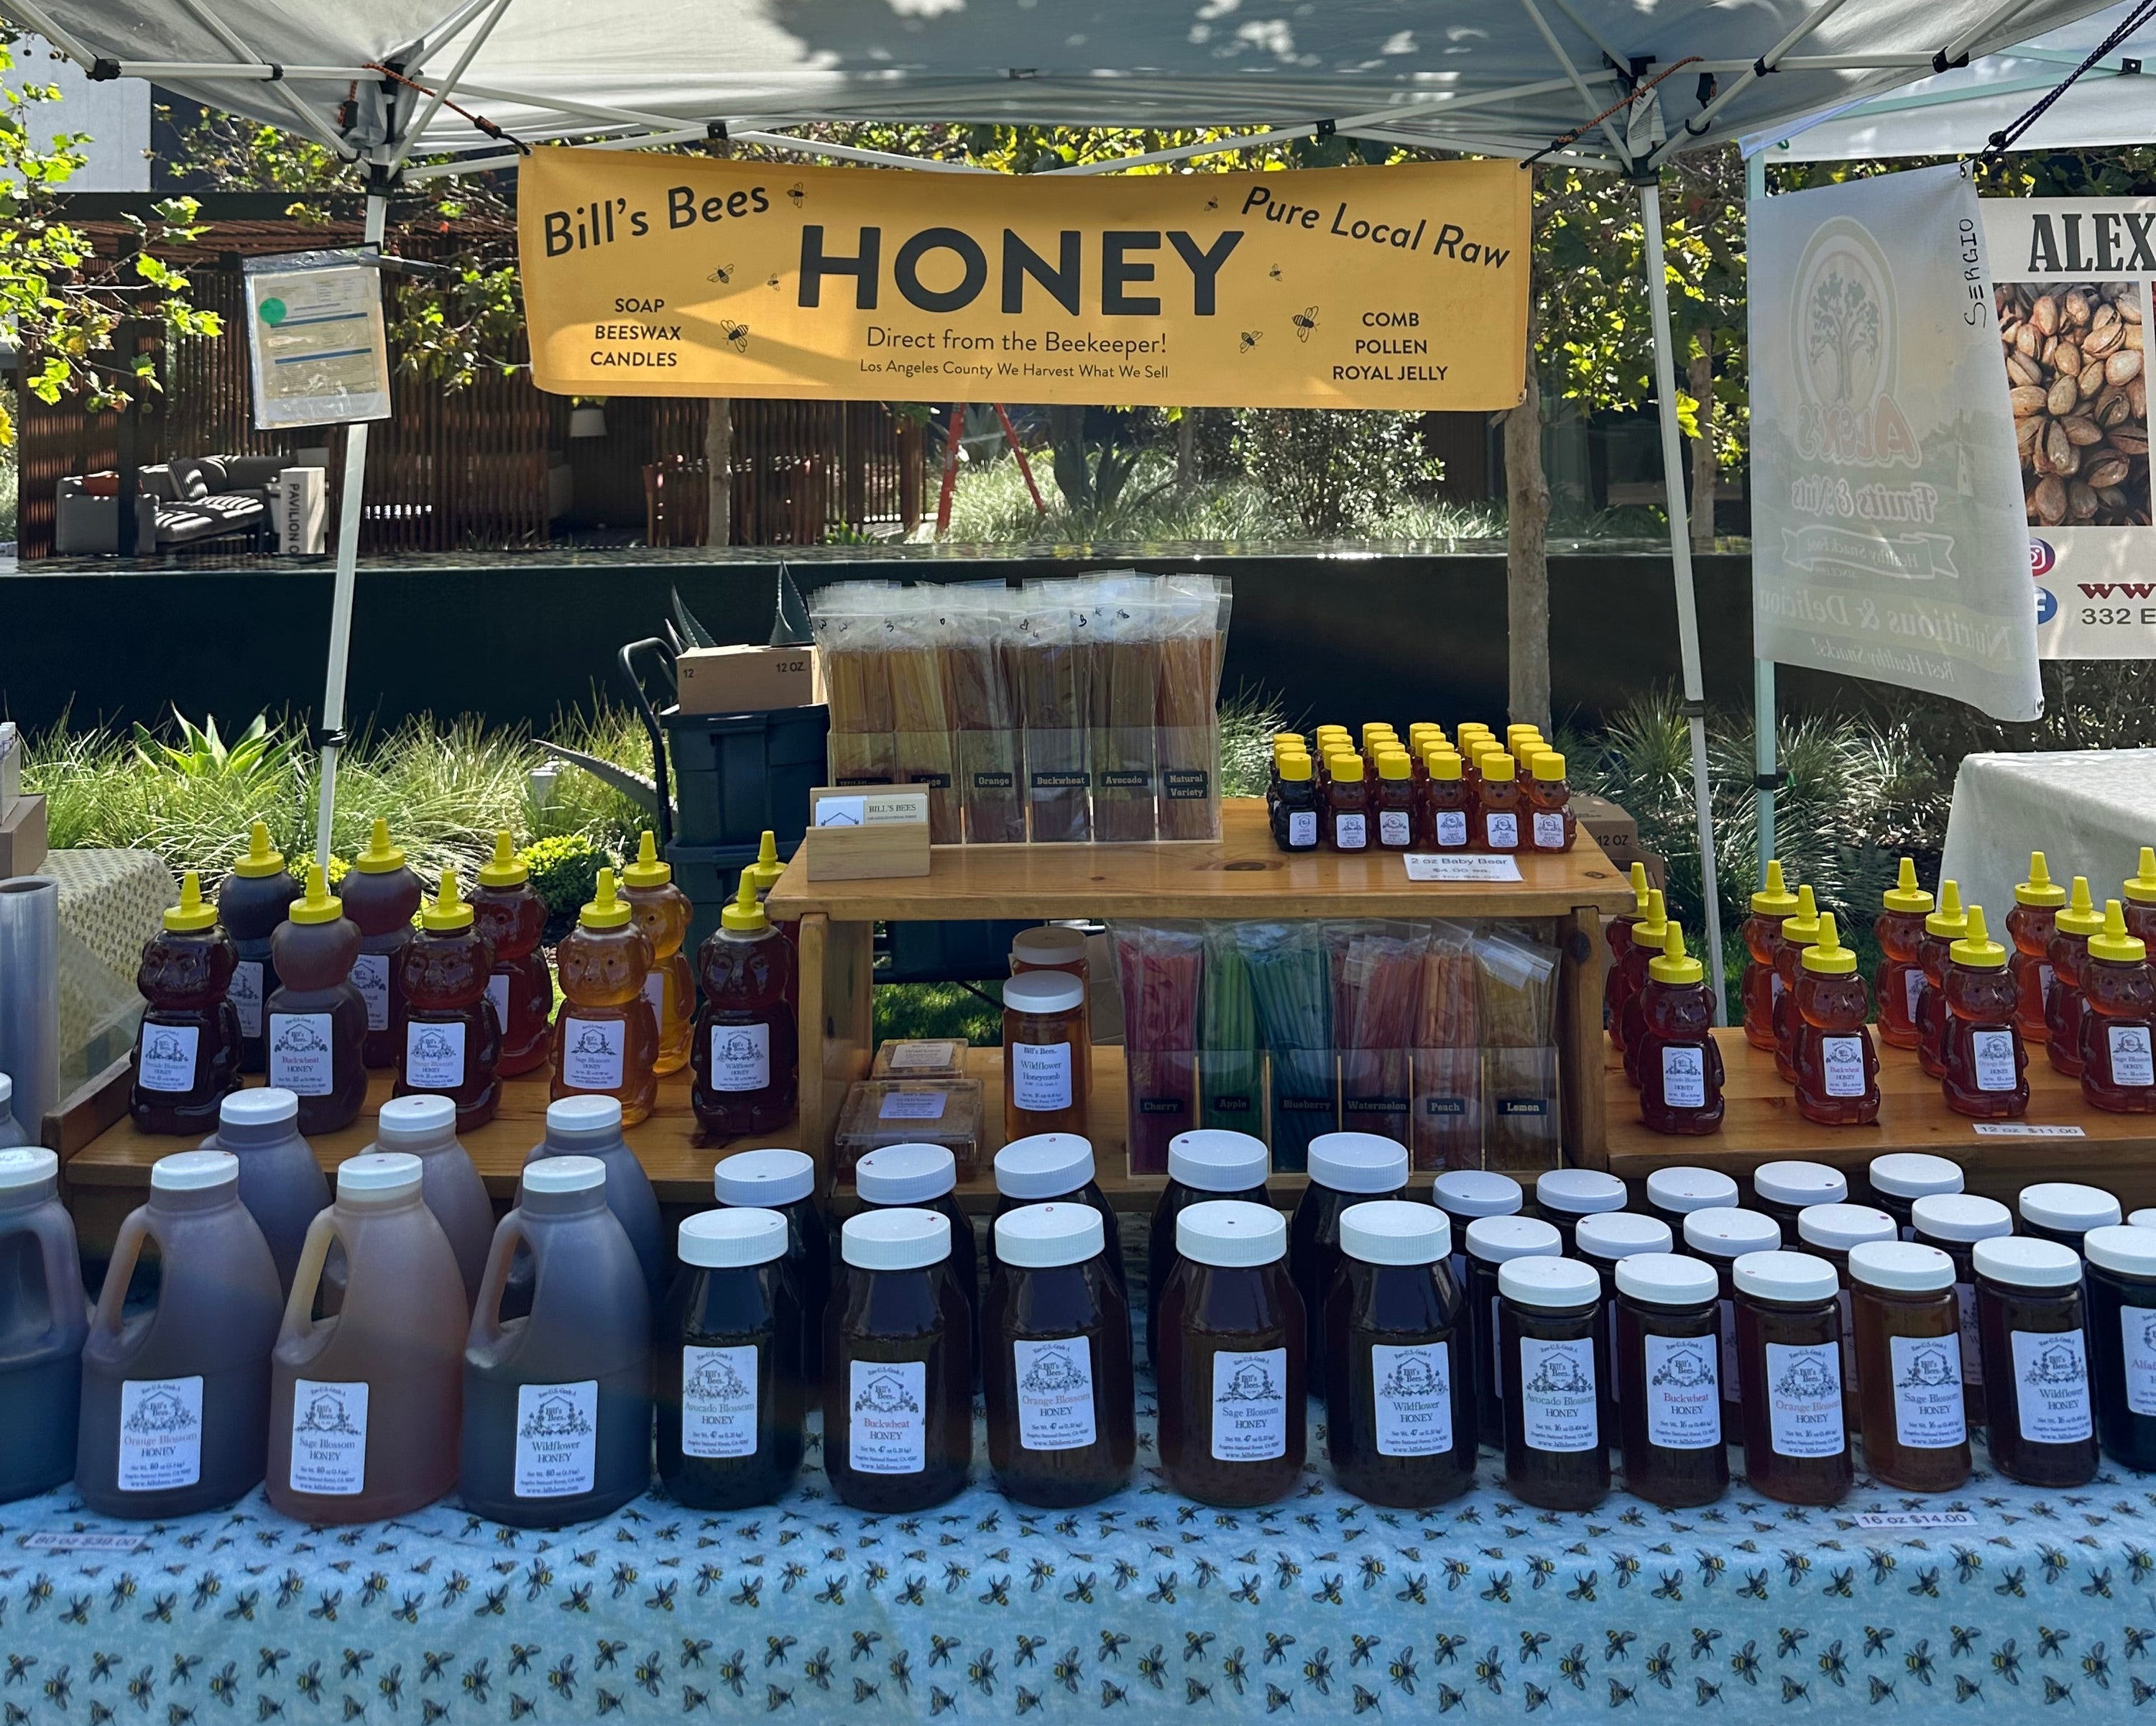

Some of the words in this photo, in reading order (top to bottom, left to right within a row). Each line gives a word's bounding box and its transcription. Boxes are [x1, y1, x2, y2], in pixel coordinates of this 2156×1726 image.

[544, 197, 649, 257] Bill's
[667, 185, 770, 231] Bees
[1242, 186, 1320, 229] Pure
[1331, 202, 1426, 250] Local
[1433, 224, 1510, 269] Raw
[2028, 214, 2156, 272] ALEX
[798, 224, 1245, 316] HONEY
[1958, 219, 1986, 329] SERGIO
[614, 298, 665, 313] SOAP
[1362, 311, 1420, 328] COMB
[595, 325, 682, 341] BEESWAX
[867, 326, 936, 349] Direct
[942, 328, 997, 351] from
[1001, 330, 1037, 352] the
[1046, 331, 1168, 360] Beekeeper!
[1355, 339, 1427, 354] POLLEN
[591, 351, 677, 367] CANDLES
[860, 359, 883, 375] Los
[886, 360, 939, 377] Angeles
[943, 361, 992, 379] County
[997, 362, 1019, 376] We
[1023, 363, 1074, 377] Harvest
[1079, 364, 1115, 378] What
[1119, 364, 1141, 378] We
[1145, 364, 1169, 379] Sell
[1333, 365, 1394, 381] ROYAL
[1397, 366, 1447, 382] JELLY
[289, 483, 300, 541] PAVILION
[2081, 608, 2131, 624] 332
[776, 662, 788, 673] 12
[683, 669, 694, 678] 12
[978, 776, 1009, 785] Orange
[1036, 776, 1085, 785] Buckwheat
[1105, 776, 1142, 784] Avocado
[1170, 789, 1203, 797] Variety
[869, 804, 894, 813] BILL'S
[895, 804, 916, 812] BEES
[1597, 835, 1610, 845] 12
[1021, 1060, 1062, 1070] Wildflower
[1023, 1072, 1060, 1081] Honeycomb
[1143, 1101, 1178, 1111] Cherry
[1219, 1099, 1247, 1108] Apple
[1284, 1099, 1331, 1110] Blueberry
[1347, 1101, 1406, 1111] Watermelon
[1431, 1103, 1461, 1111] Peach
[1506, 1103, 1540, 1111] Lemon
[1664, 1392, 1709, 1403] Buckwheat
[1904, 1392, 1927, 1404] Sage
[2040, 1387, 2083, 1398] Wildflower
[1022, 1395, 1054, 1407] Orange
[1056, 1393, 1090, 1404] Blossom
[1526, 1393, 1561, 1405] Avocado
[1564, 1395, 1595, 1405] Blossom
[685, 1402, 717, 1413] Avocado
[719, 1403, 755, 1413] Blossom
[1393, 1402, 1440, 1411] Wildflower
[1671, 1405, 1704, 1415] HONEY
[1775, 1400, 1810, 1413] Orange
[1919, 1405, 1950, 1415] HONEY
[2047, 1400, 2080, 1410] HONEY
[1040, 1407, 1073, 1416] HONEY
[1222, 1407, 1244, 1418] Sage
[1246, 1407, 1279, 1417] Blossom
[1545, 1408, 1579, 1417] HONEY
[702, 1415, 735, 1425] HONEY
[864, 1418, 910, 1428] Buckwheat
[1401, 1413, 1433, 1423] HONEY
[1796, 1414, 1828, 1423] HONEY
[1235, 1419, 1268, 1429] HONEY
[124, 1436, 156, 1446] Orange
[160, 1433, 198, 1443] Blossom
[870, 1431, 903, 1440] HONEY
[299, 1436, 318, 1449] Sage
[320, 1438, 355, 1449] Blossom
[532, 1441, 581, 1452] Wildflower
[142, 1446, 176, 1457] HONEY
[310, 1451, 341, 1461] HONEY
[538, 1452, 572, 1463] HONEY
[1861, 1515, 1882, 1524] 16
[1909, 1514, 1968, 1524] $14.00
